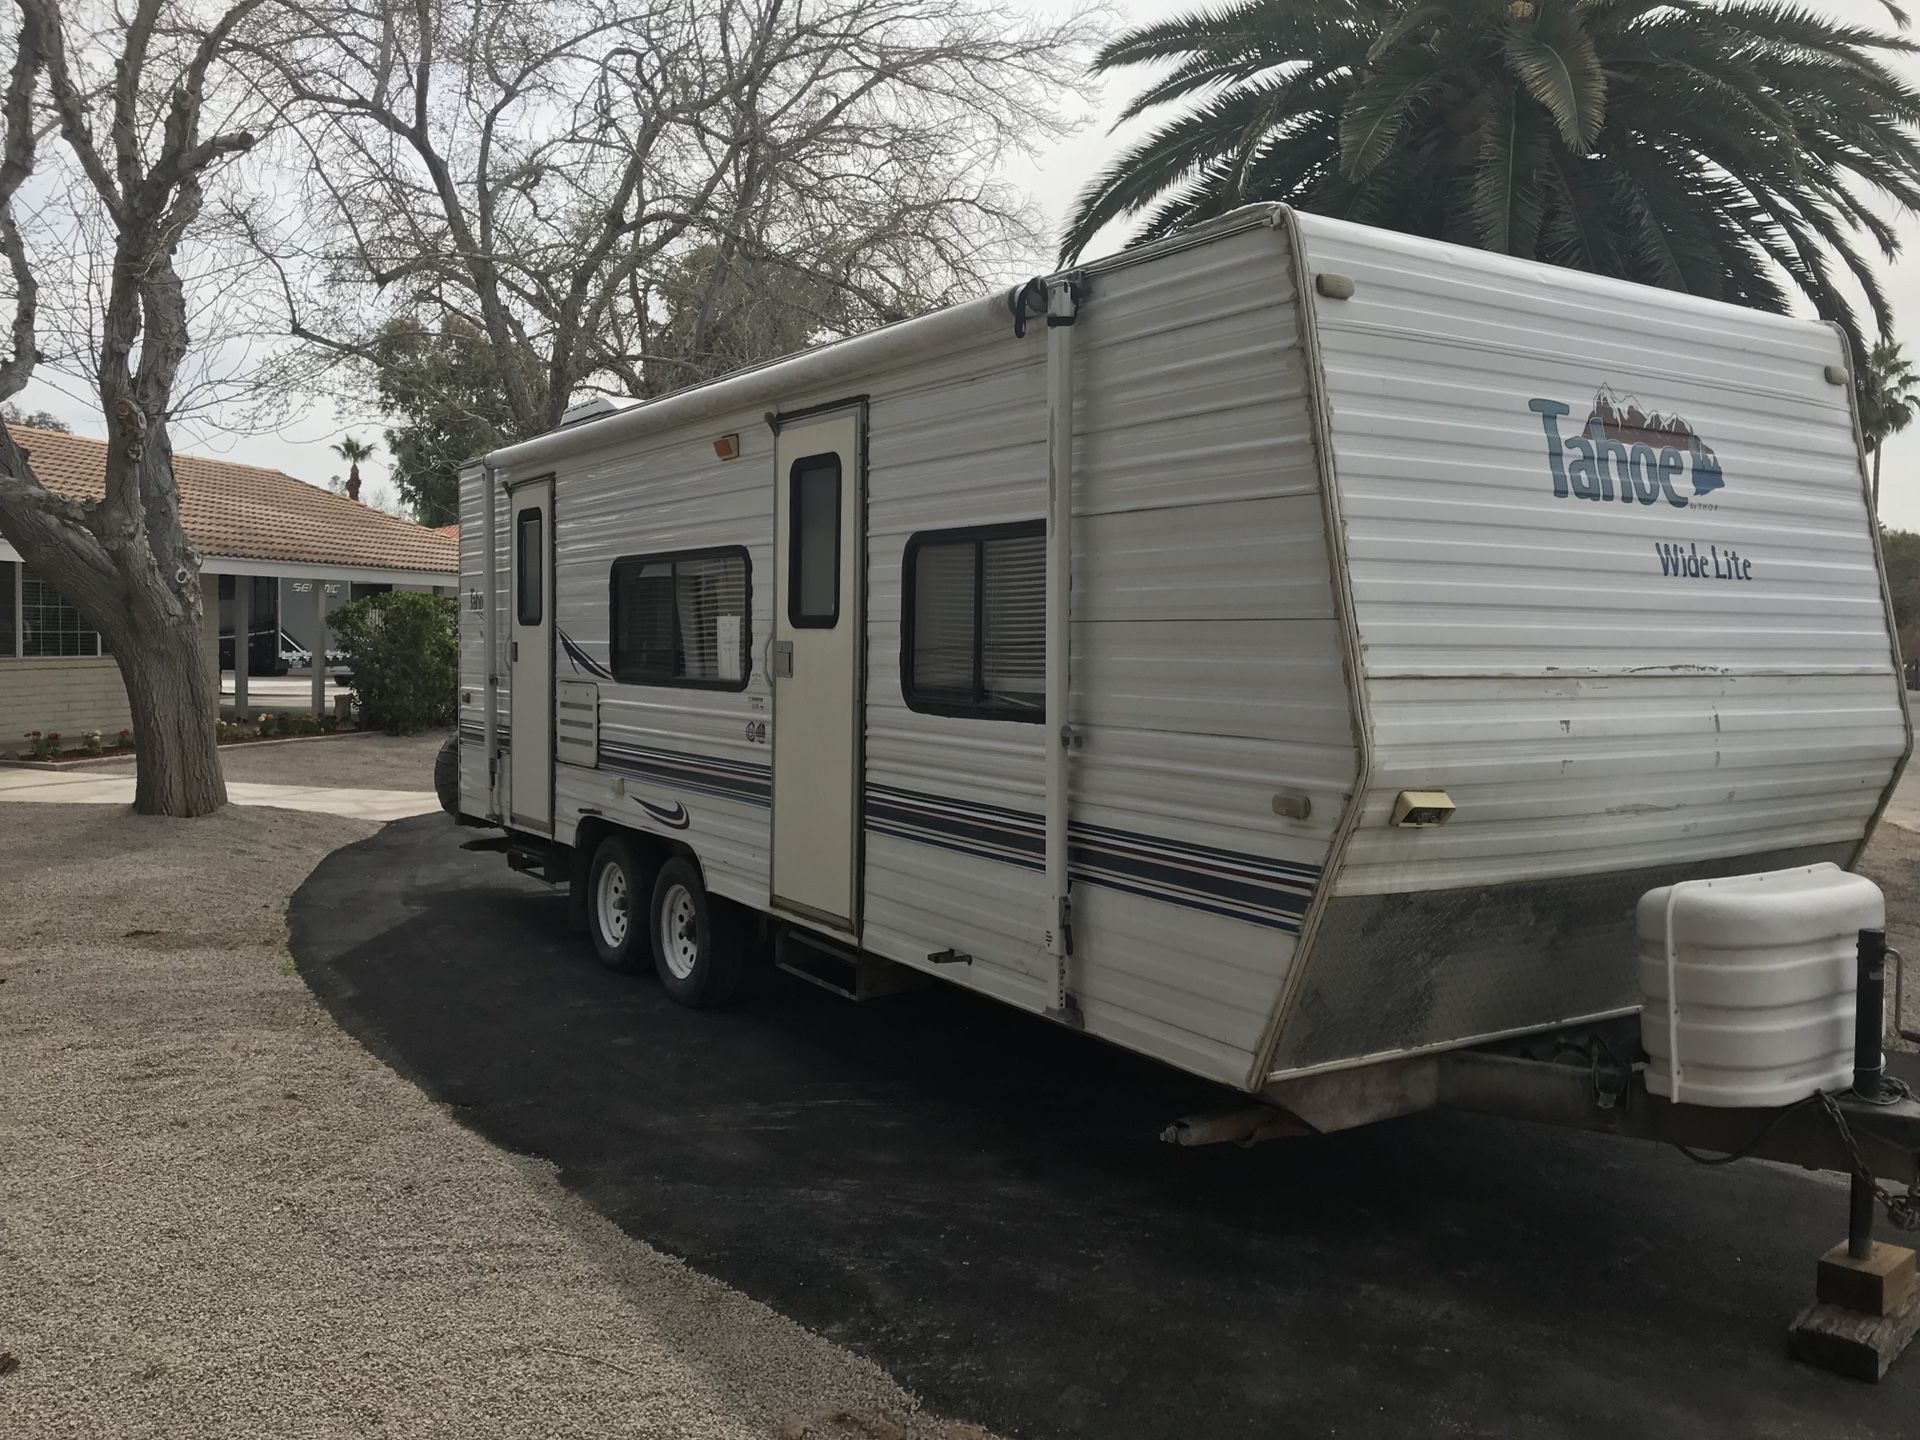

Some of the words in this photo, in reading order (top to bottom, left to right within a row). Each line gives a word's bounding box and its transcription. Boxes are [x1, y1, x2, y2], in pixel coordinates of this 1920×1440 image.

[1528, 398, 1689, 508] Tahoe
[1655, 542, 1710, 579] Wide
[1711, 545, 1753, 580] Lite
